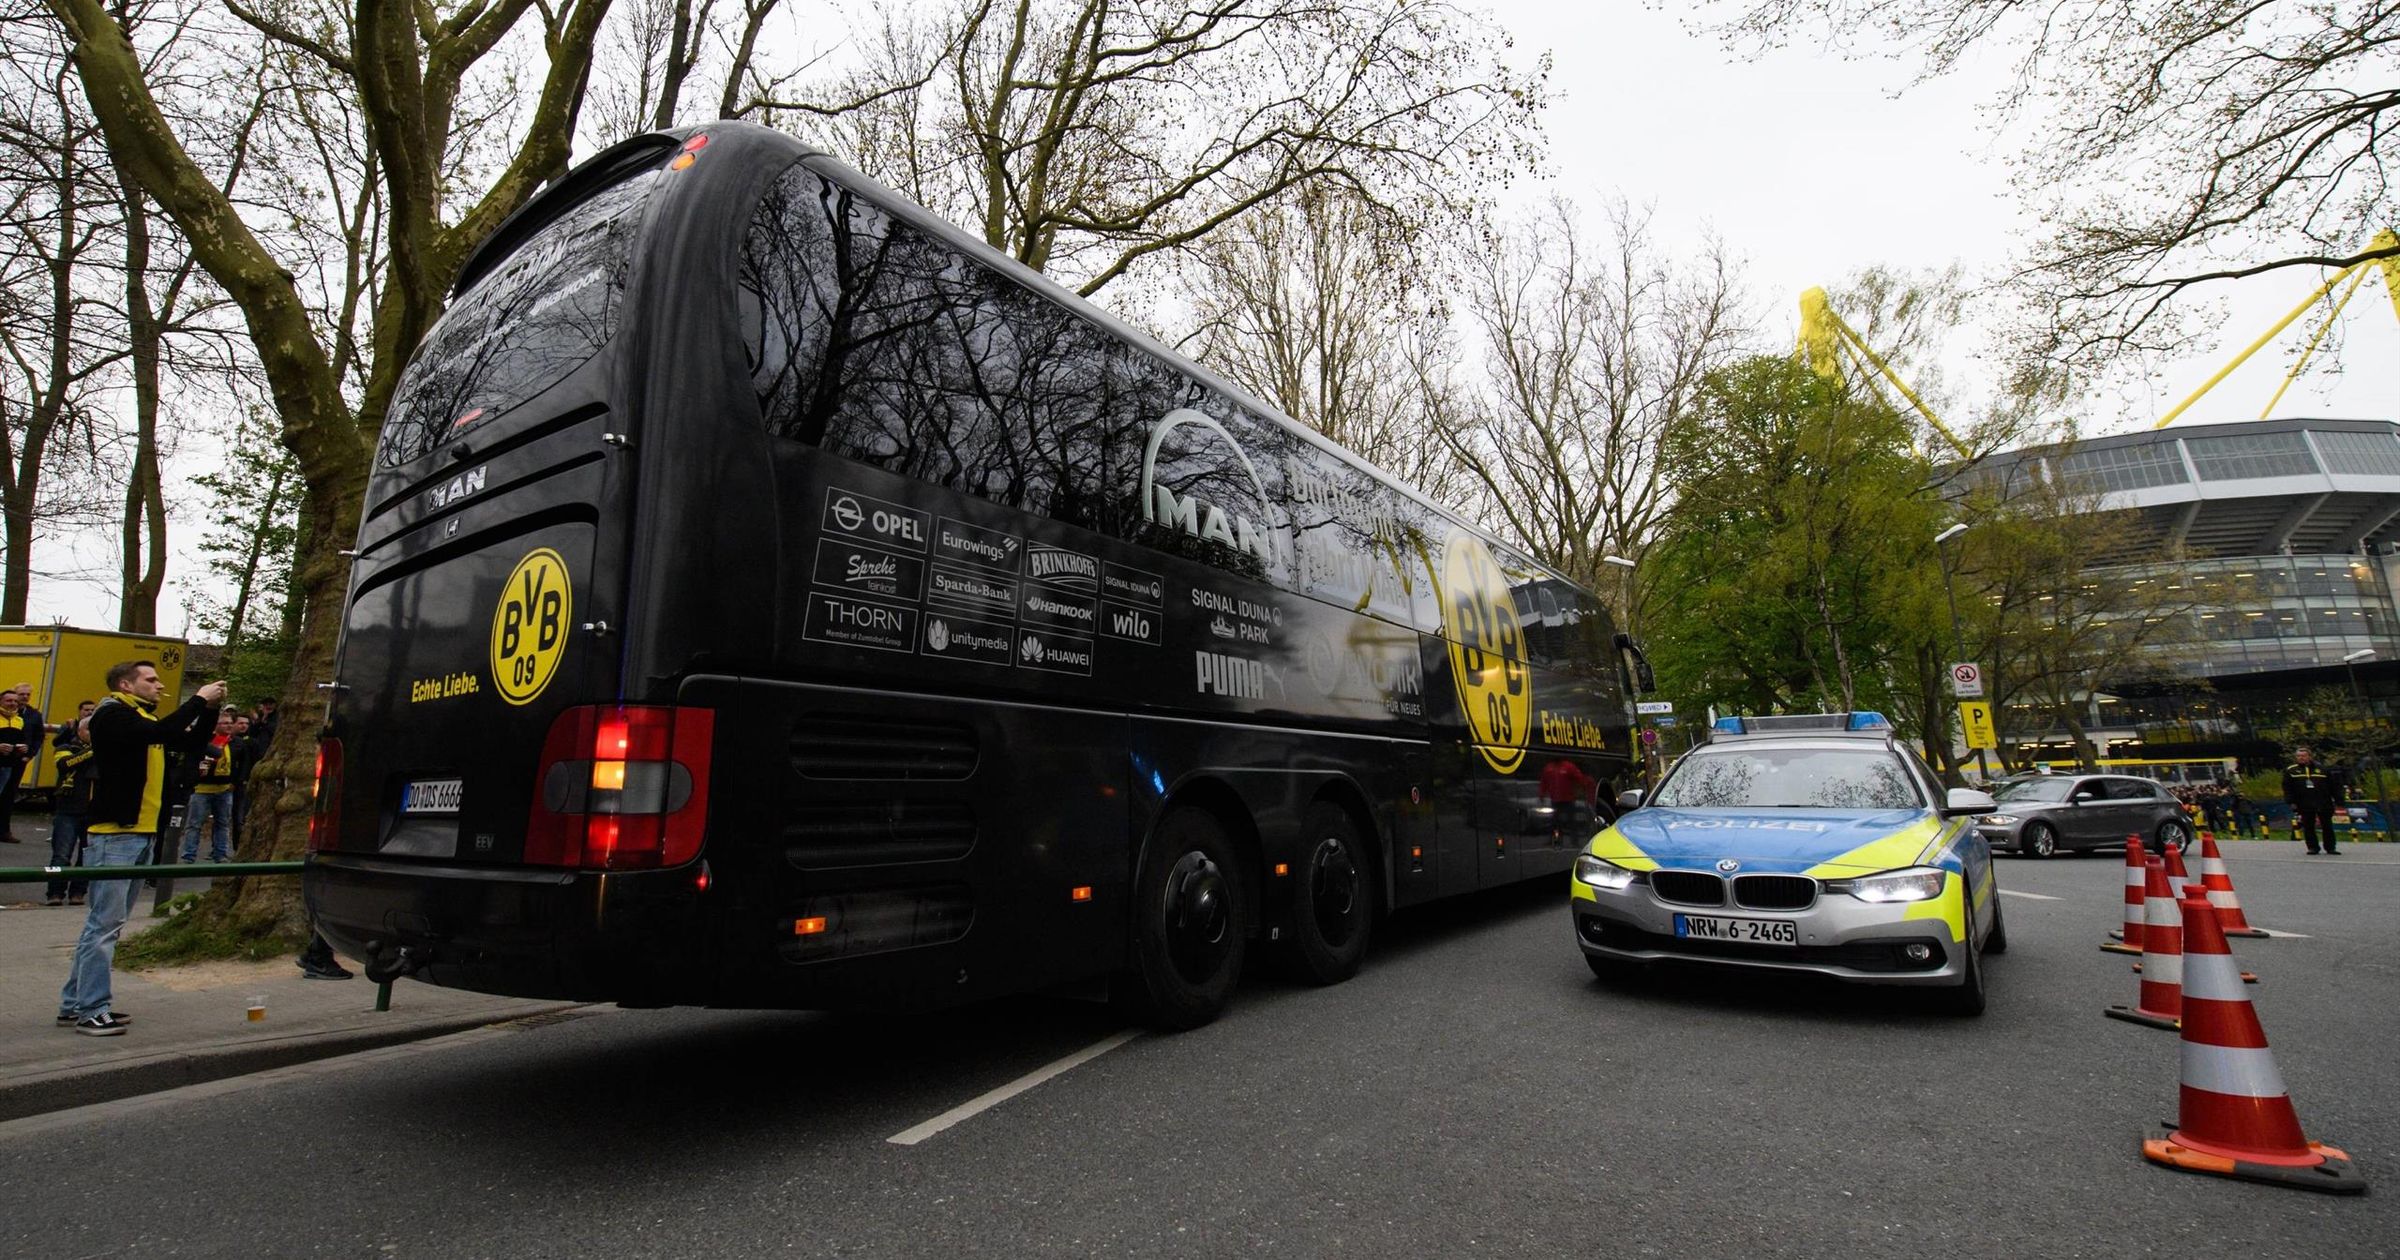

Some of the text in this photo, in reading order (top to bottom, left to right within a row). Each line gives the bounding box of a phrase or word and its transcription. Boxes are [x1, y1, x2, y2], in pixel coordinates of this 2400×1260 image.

[428, 465, 487, 512] MAN
[872, 510, 924, 542] OPEL
[1156, 483, 1271, 563] MAN
[942, 531, 1004, 561] Eurowings
[935, 574, 1011, 601] Sparda-Bank
[1105, 575, 1150, 595] SIGNAL IDUNA
[500, 564, 561, 659] BVB
[824, 600, 902, 632] THORN
[1191, 588, 1272, 624] SIGNAL IDUNA
[1113, 610, 1150, 639] wilo
[1240, 623, 1270, 644] PARK
[1455, 550, 1522, 696] BVB
[951, 632, 1009, 651] unitymedia
[513, 654, 535, 687] 09
[1047, 649, 1090, 666] HUAWEI
[412, 672, 480, 703] Echte Liebe.
[1195, 650, 1264, 699] PUMA
[1488, 692, 1512, 743] 09
[1541, 710, 1606, 749] Echte Liebe.
[1972, 708, 1983, 724] P
[1668, 819, 1826, 832] POLIZEI
[1685, 917, 1795, 942] NRW 6-2465
